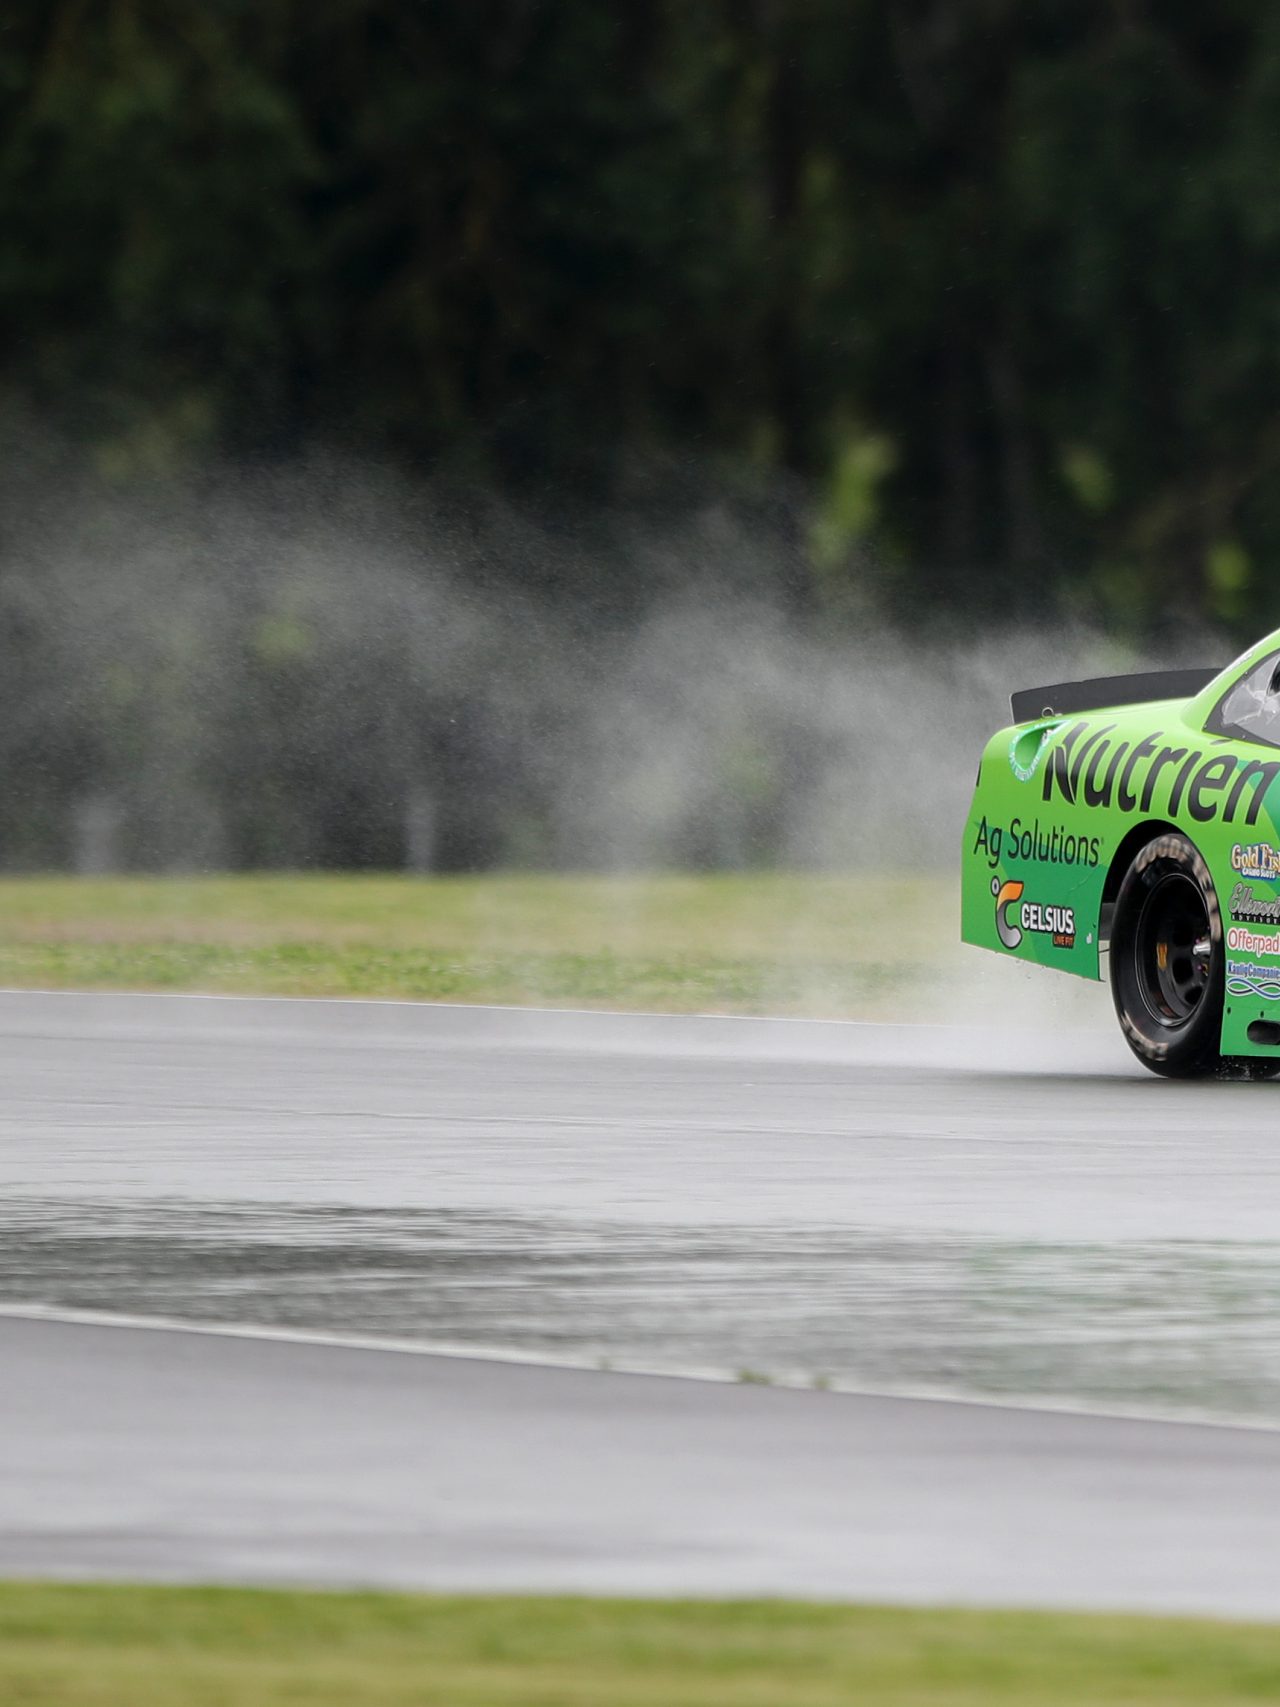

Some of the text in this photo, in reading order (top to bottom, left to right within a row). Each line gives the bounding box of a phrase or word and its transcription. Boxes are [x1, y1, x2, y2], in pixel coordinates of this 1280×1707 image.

[973, 815, 1100, 869] Ag Solutions
[1232, 844, 1259, 870] Gold
[1021, 902, 1075, 935] CELSIUS
[1227, 928, 1280, 957] Offerpad
